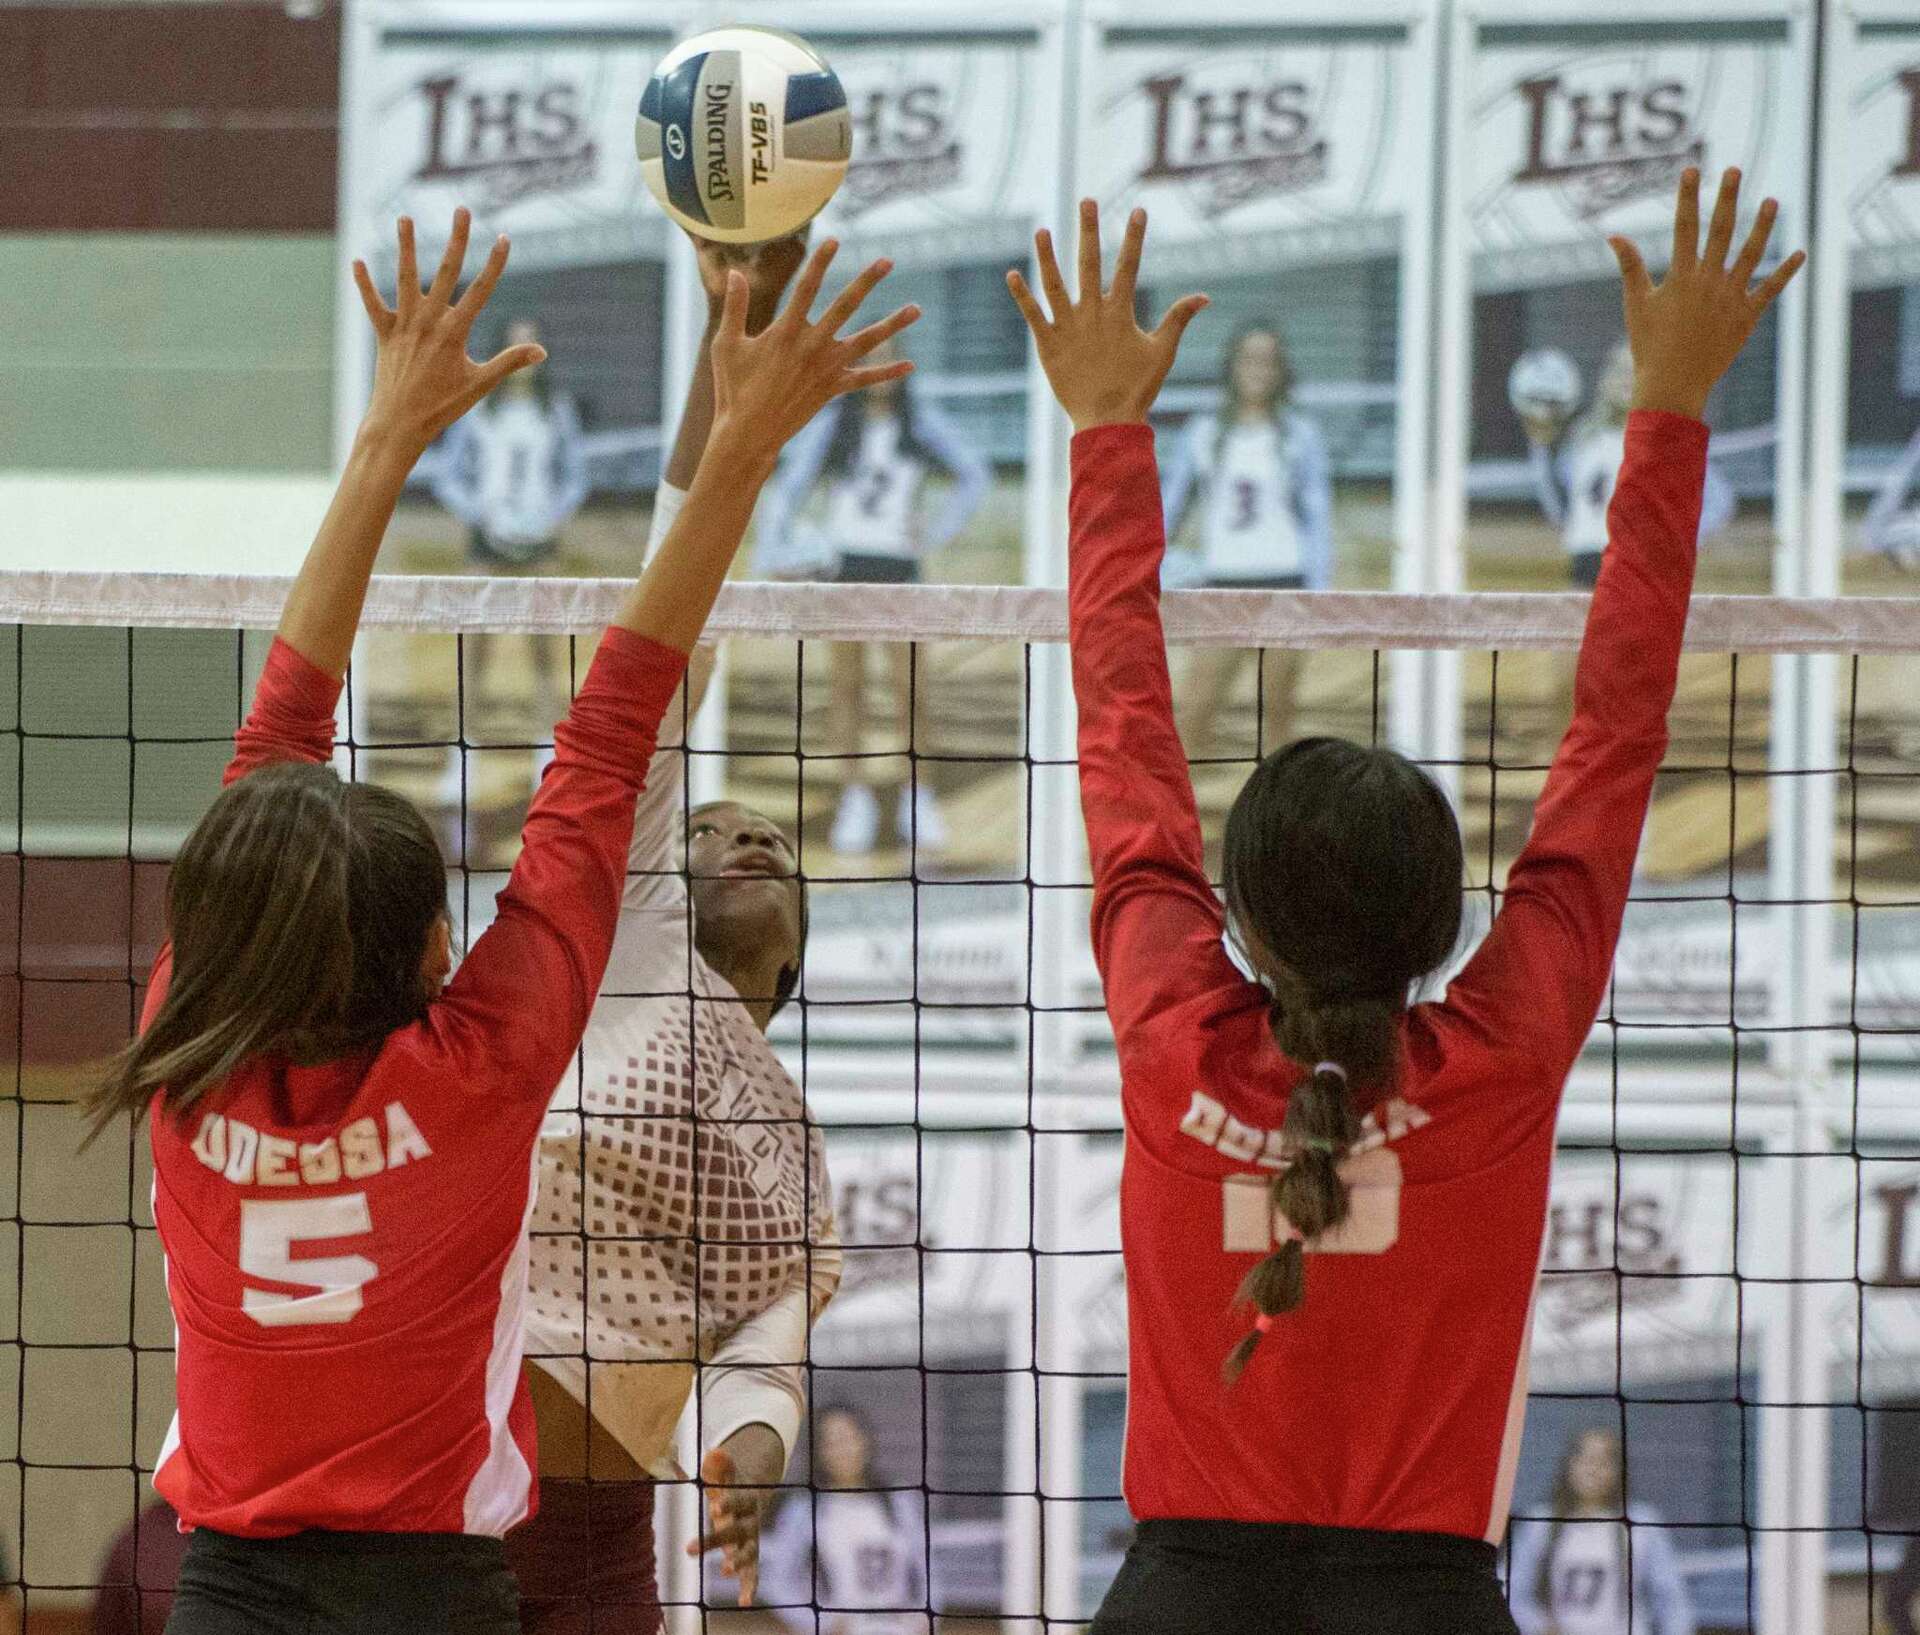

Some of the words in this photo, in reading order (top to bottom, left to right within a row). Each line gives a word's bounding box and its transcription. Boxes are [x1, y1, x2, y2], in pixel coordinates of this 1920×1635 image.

[706, 83, 735, 202] SPALDING
[749, 101, 769, 185] TF-VB5
[238, 1191, 379, 1328] 5
[1547, 1195, 1663, 1258] HS
